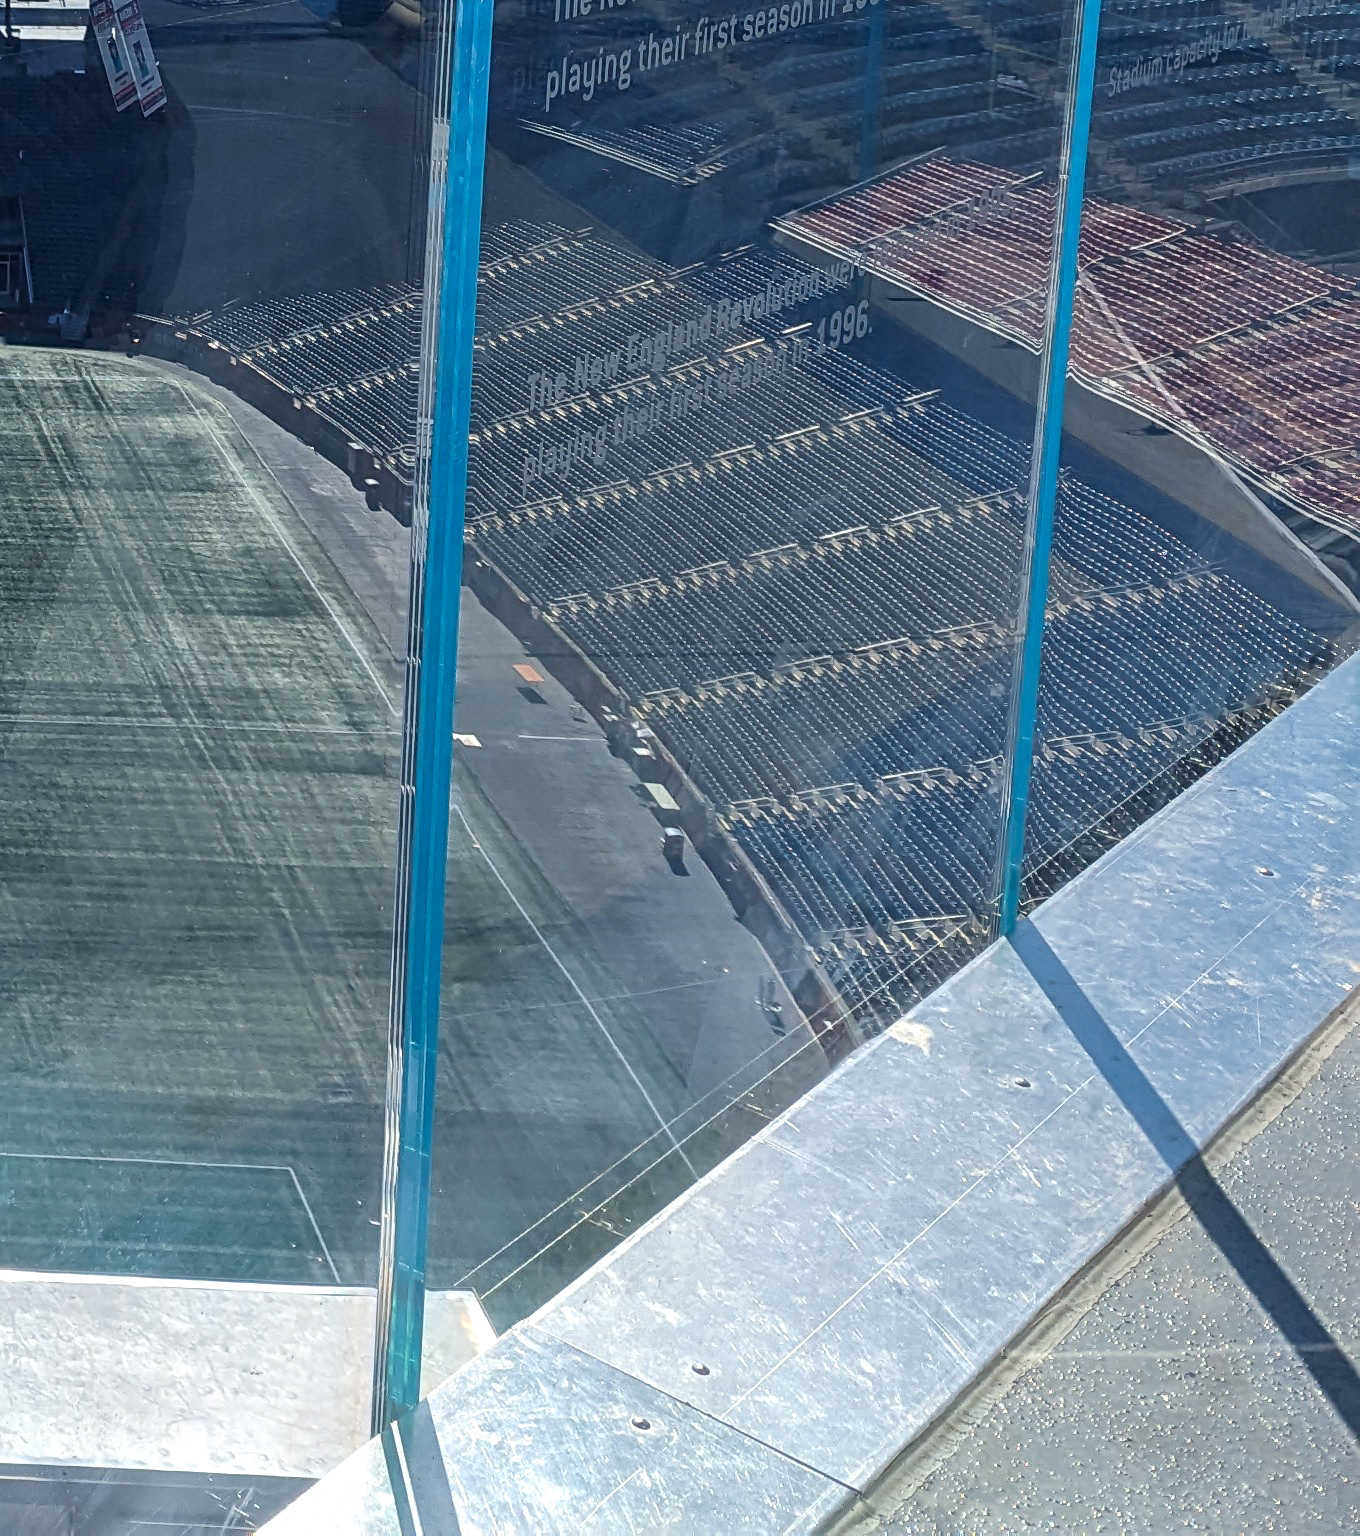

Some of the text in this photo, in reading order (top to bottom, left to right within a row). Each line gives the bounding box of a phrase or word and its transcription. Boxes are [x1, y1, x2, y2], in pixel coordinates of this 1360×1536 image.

[546, 47, 631, 112] playing
[638, 25, 689, 72] their
[695, 16, 737, 55] first
[1108, 54, 1163, 97] Stadium
[1166, 29, 1220, 74] capacity
[523, 421, 607, 496] playing
[614, 395, 665, 446] their
[670, 375, 712, 421] first
[717, 350, 787, 400] season
[816, 300, 873, 355] 1996.
[528, 369, 566, 411] The
[575, 353, 620, 392] New
[627, 304, 712, 372] England
[717, 270, 820, 335] Revolution
